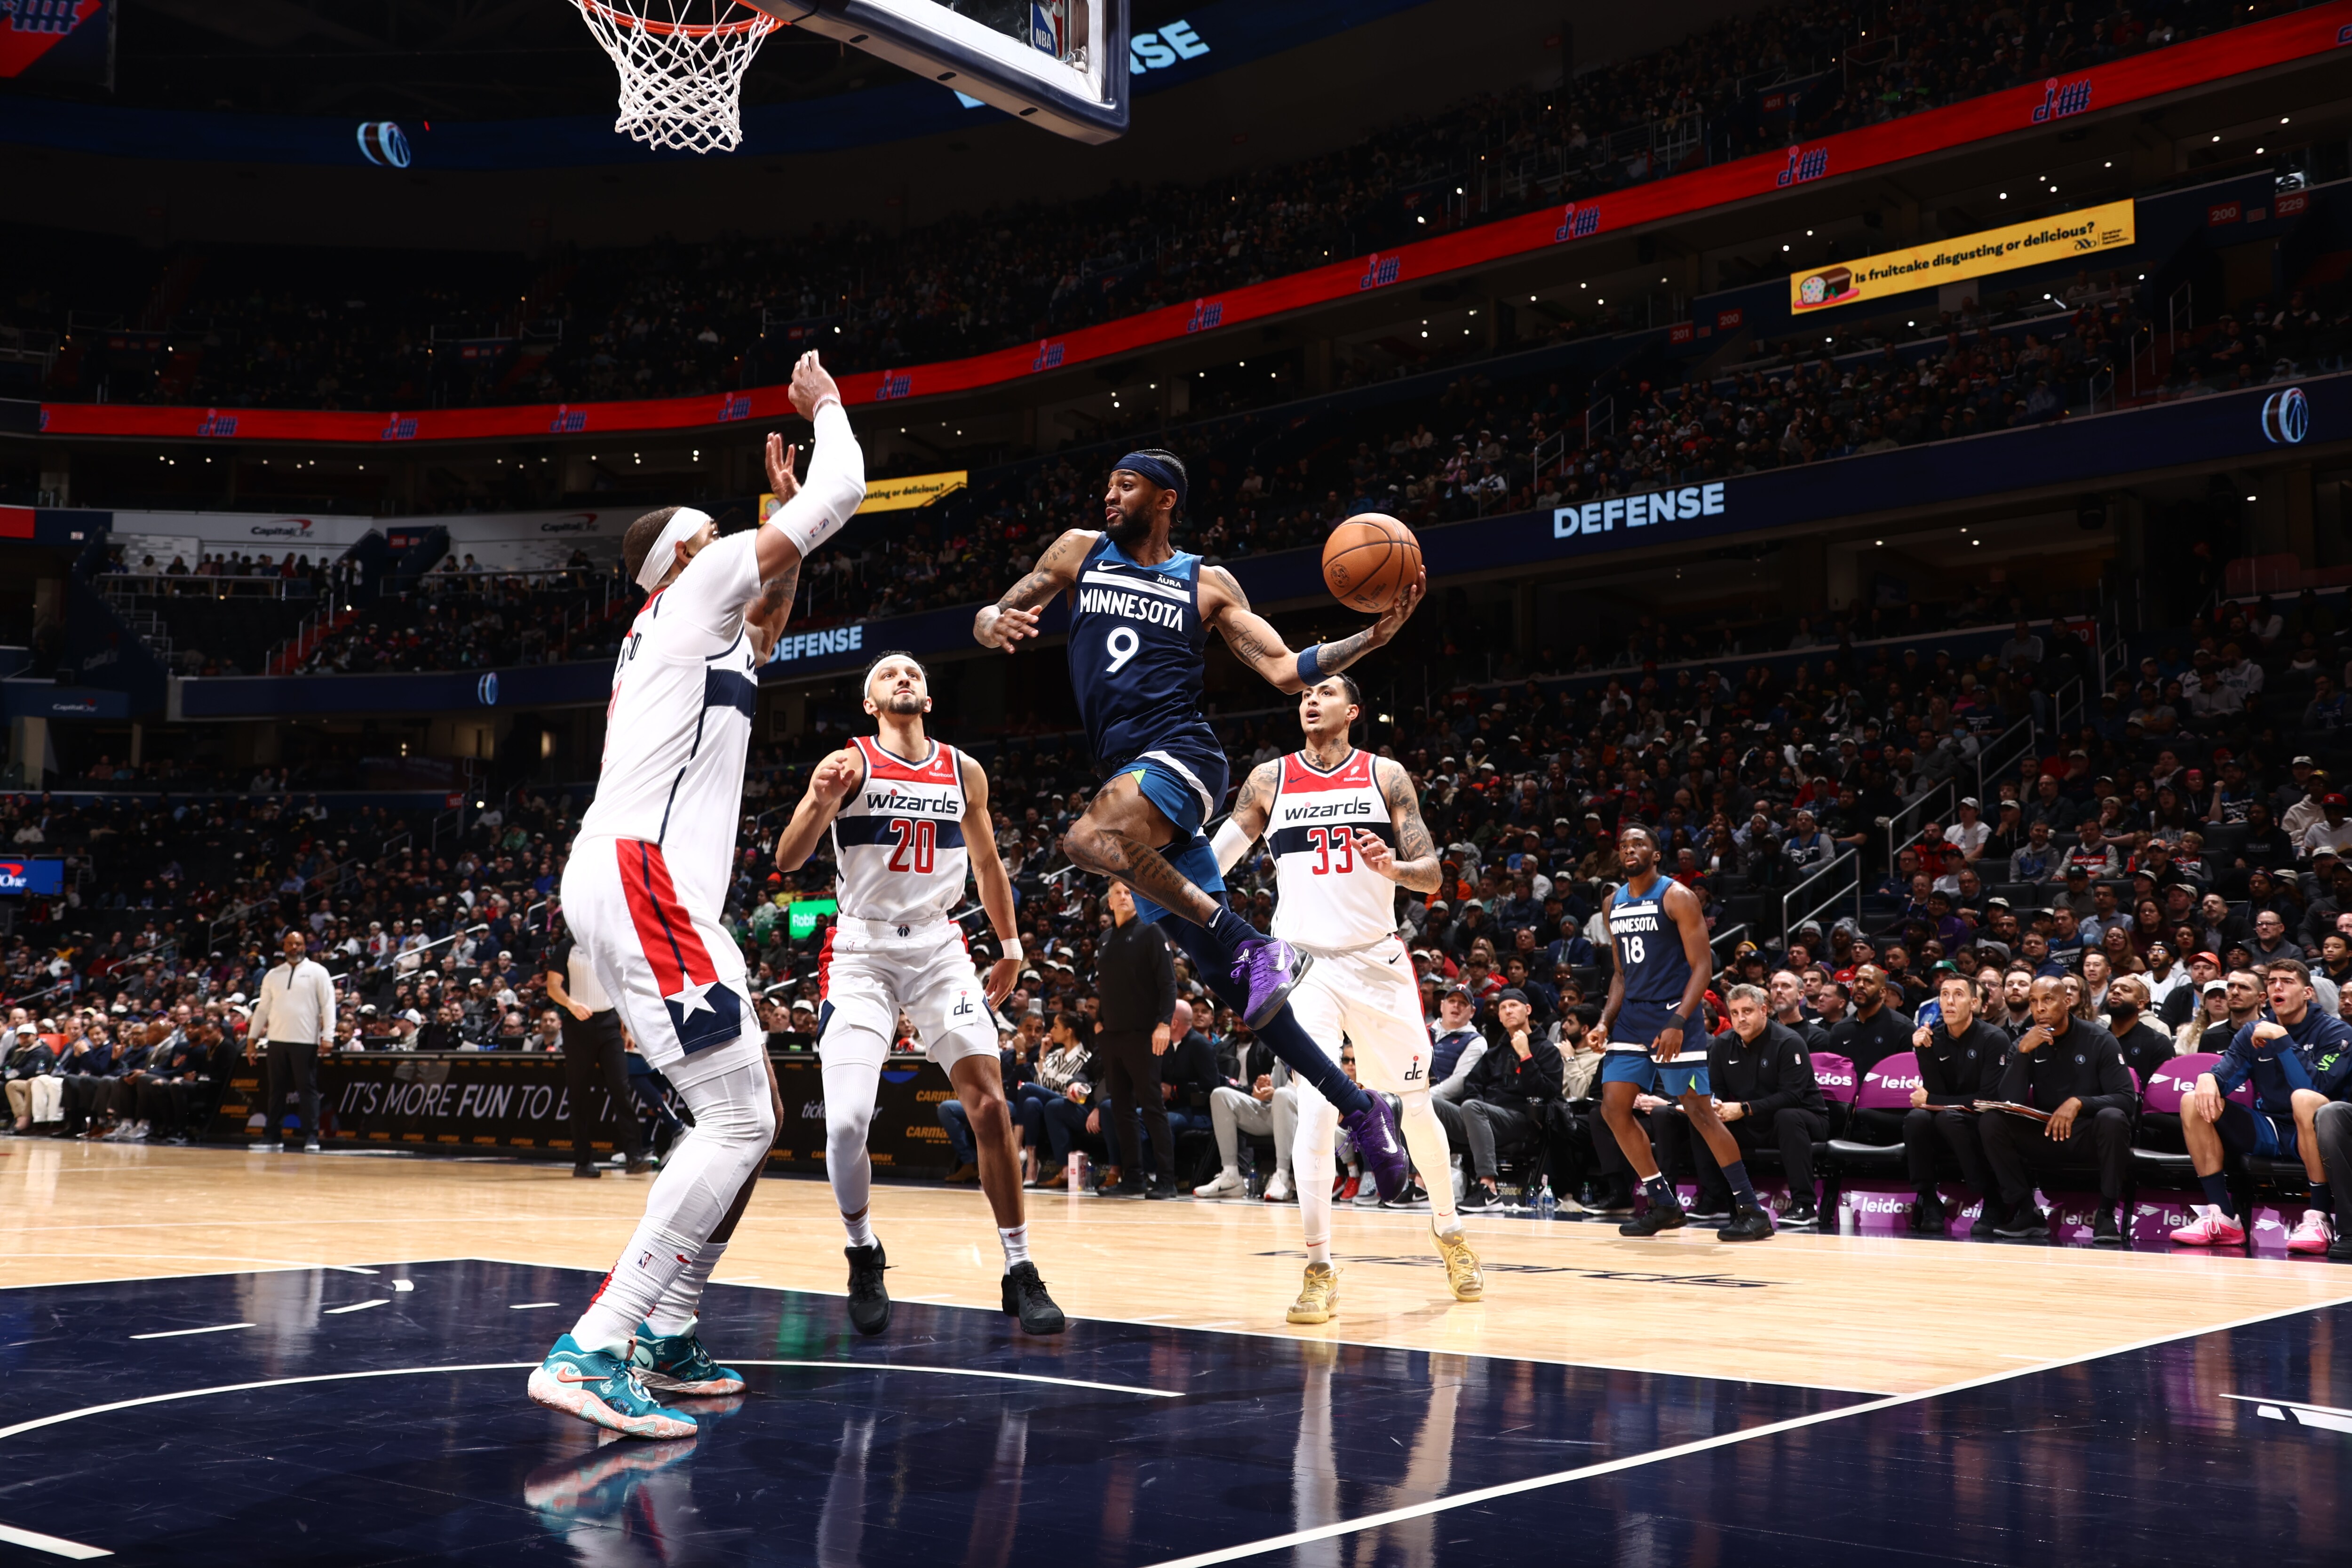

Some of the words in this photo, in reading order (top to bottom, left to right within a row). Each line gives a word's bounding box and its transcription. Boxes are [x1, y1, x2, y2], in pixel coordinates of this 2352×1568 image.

[1035, 27, 1052, 50] NBA
[2212, 207, 2237, 222] 200
[2279, 198, 2304, 212] 229
[1855, 271, 1866, 284] Is
[1869, 258, 1929, 282] fruitcake
[1932, 243, 2003, 267] disgusting
[2006, 239, 2020, 251] or
[2024, 221, 2095, 247] delicious?
[1720, 313, 1739, 326] 200
[1672, 328, 1689, 340] 201
[903, 483, 944, 495] delicious?
[1554, 482, 1724, 539] DEFENSE
[1080, 588, 1182, 632] MINNESOTA
[1105, 625, 1140, 674] 9
[889, 818, 937, 874] 20
[1307, 826, 1354, 876] 33
[1609, 916, 1659, 935] MINNESOTA
[1621, 936, 1645, 964] 18
[1814, 1072, 1852, 1087] idos
[1881, 1075, 1923, 1090] leid
[338, 1082, 382, 1115] IT'S
[381, 1082, 458, 1117] MORE
[457, 1083, 513, 1119] FUN
[517, 1084, 553, 1120] TO
[1861, 1196, 1913, 1214] leidos
